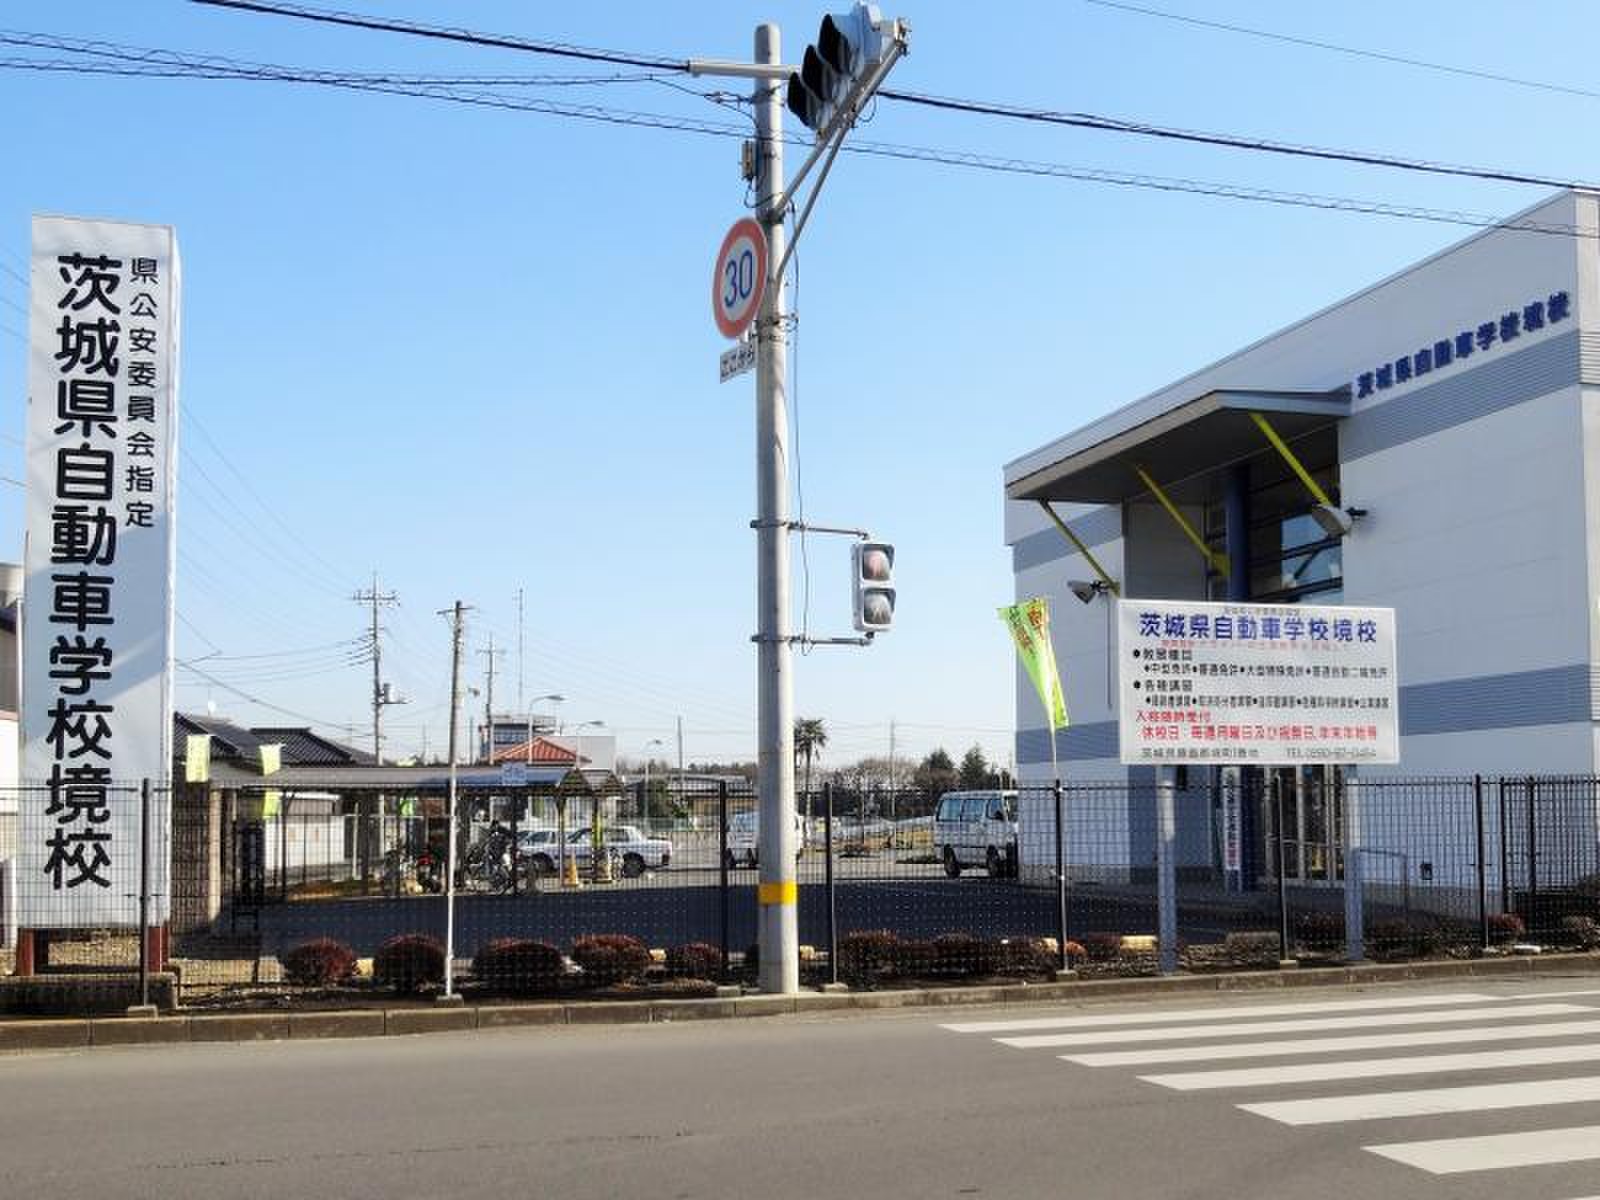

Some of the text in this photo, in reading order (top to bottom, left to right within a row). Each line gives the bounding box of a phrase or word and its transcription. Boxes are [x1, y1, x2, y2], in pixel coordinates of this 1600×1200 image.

[723, 249, 752, 308] 30
[125, 257, 158, 528] 県公安委員会指定
[45, 252, 122, 891] 茨城県自動車学校境校
[1139, 612, 1377, 643] 茨城県自動車学校境校
